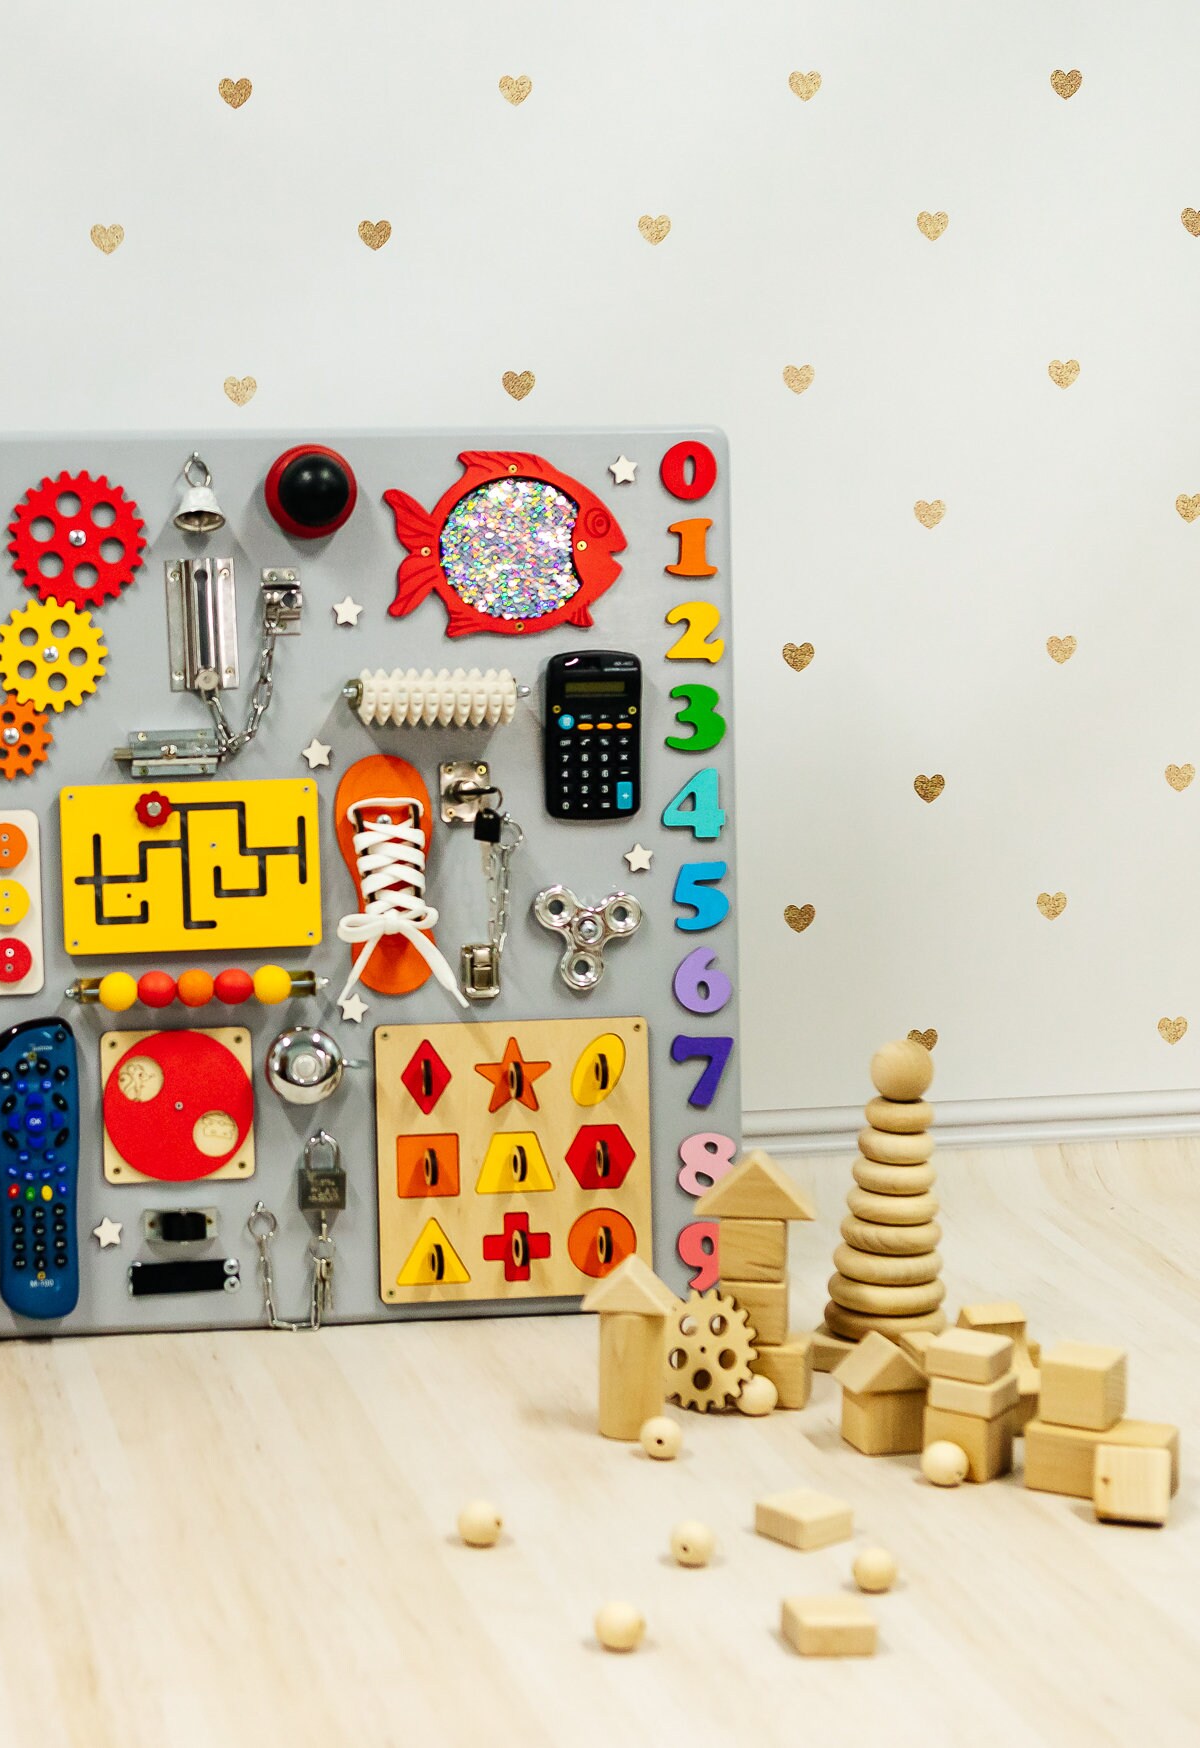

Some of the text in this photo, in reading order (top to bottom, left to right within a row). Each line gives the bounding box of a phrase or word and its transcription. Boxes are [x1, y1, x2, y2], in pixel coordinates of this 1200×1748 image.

[661, 440, 717, 499] 0
[665, 518, 718, 576] 1
[665, 601, 725, 663] 2
[665, 684, 726, 751] 3
[661, 768, 726, 838] 4
[672, 861, 729, 931] 5
[673, 947, 732, 1014] 6
[671, 1034, 733, 1105] 7
[678, 1132, 737, 1197] 8
[677, 1221, 719, 1289] 9
